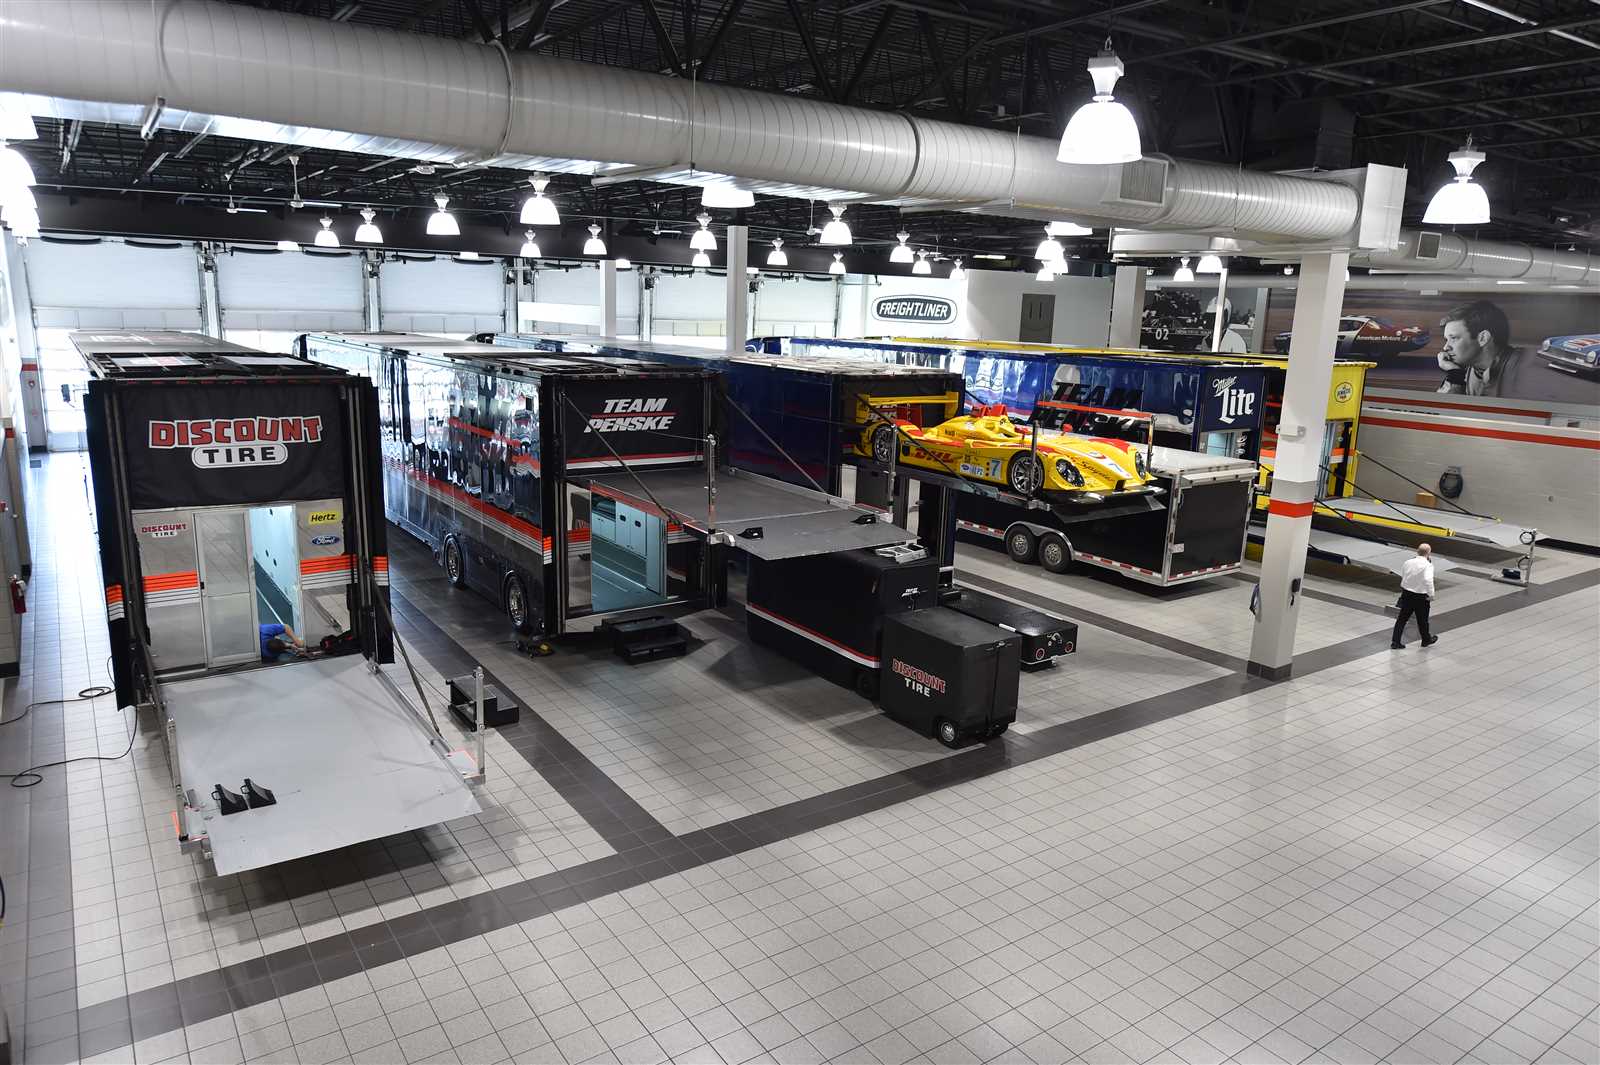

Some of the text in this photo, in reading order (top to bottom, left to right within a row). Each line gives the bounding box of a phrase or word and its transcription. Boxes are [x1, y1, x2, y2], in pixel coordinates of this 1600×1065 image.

[879, 301, 948, 317] FREIGHTLINER
[1155, 328, 1169, 341] 02
[1212, 375, 1237, 394] Miller
[603, 398, 668, 413] TEAM
[1214, 388, 1255, 424] Lite
[149, 417, 321, 447] DISCOUNT
[584, 416, 674, 433] PENSKE
[203, 447, 276, 463] TIRE
[990, 459, 1001, 476] 7
[311, 513, 337, 522] Hertz
[141, 523, 188, 533] DISCOUNT
[314, 535, 337, 545] Ford
[892, 658, 946, 694] DISCOUNT
[904, 677, 930, 697] TIRE
